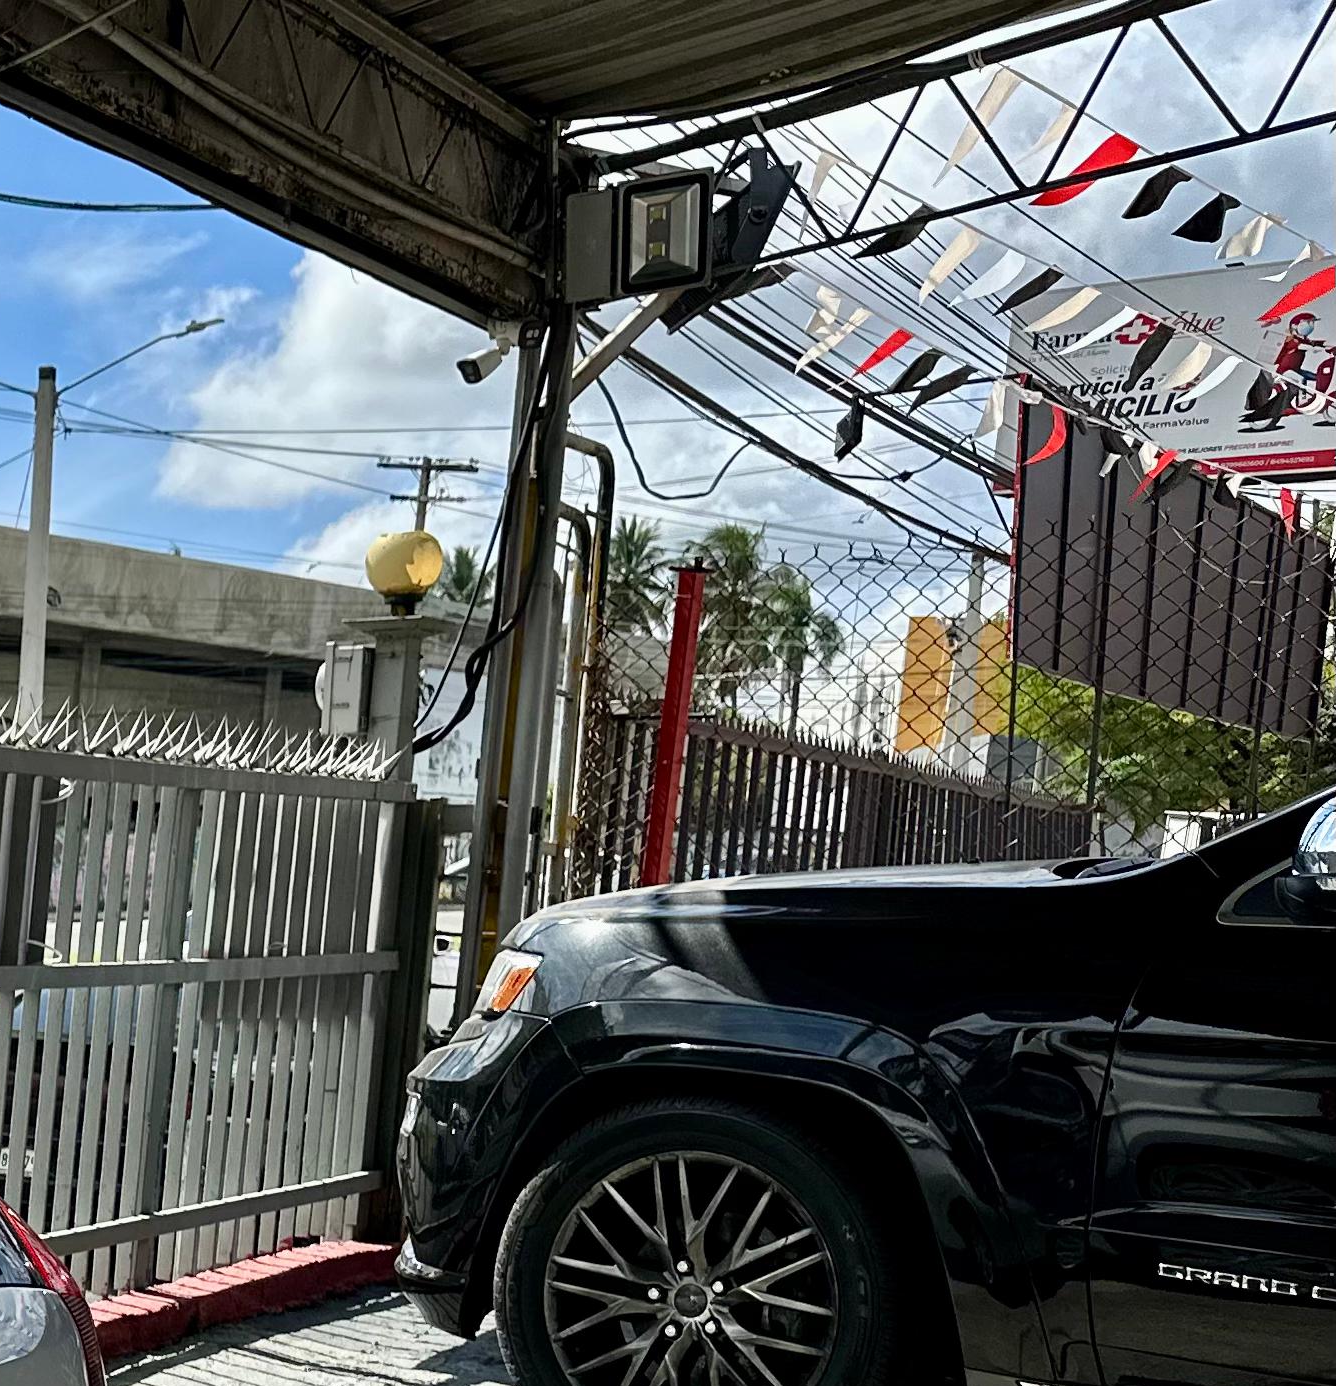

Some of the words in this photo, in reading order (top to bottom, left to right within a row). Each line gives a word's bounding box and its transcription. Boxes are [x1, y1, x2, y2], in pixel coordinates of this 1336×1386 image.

[1139, 376, 1155, 391] a
[1142, 416, 1210, 430] FarmaValue
[1157, 1261, 1298, 1297] GRAND
